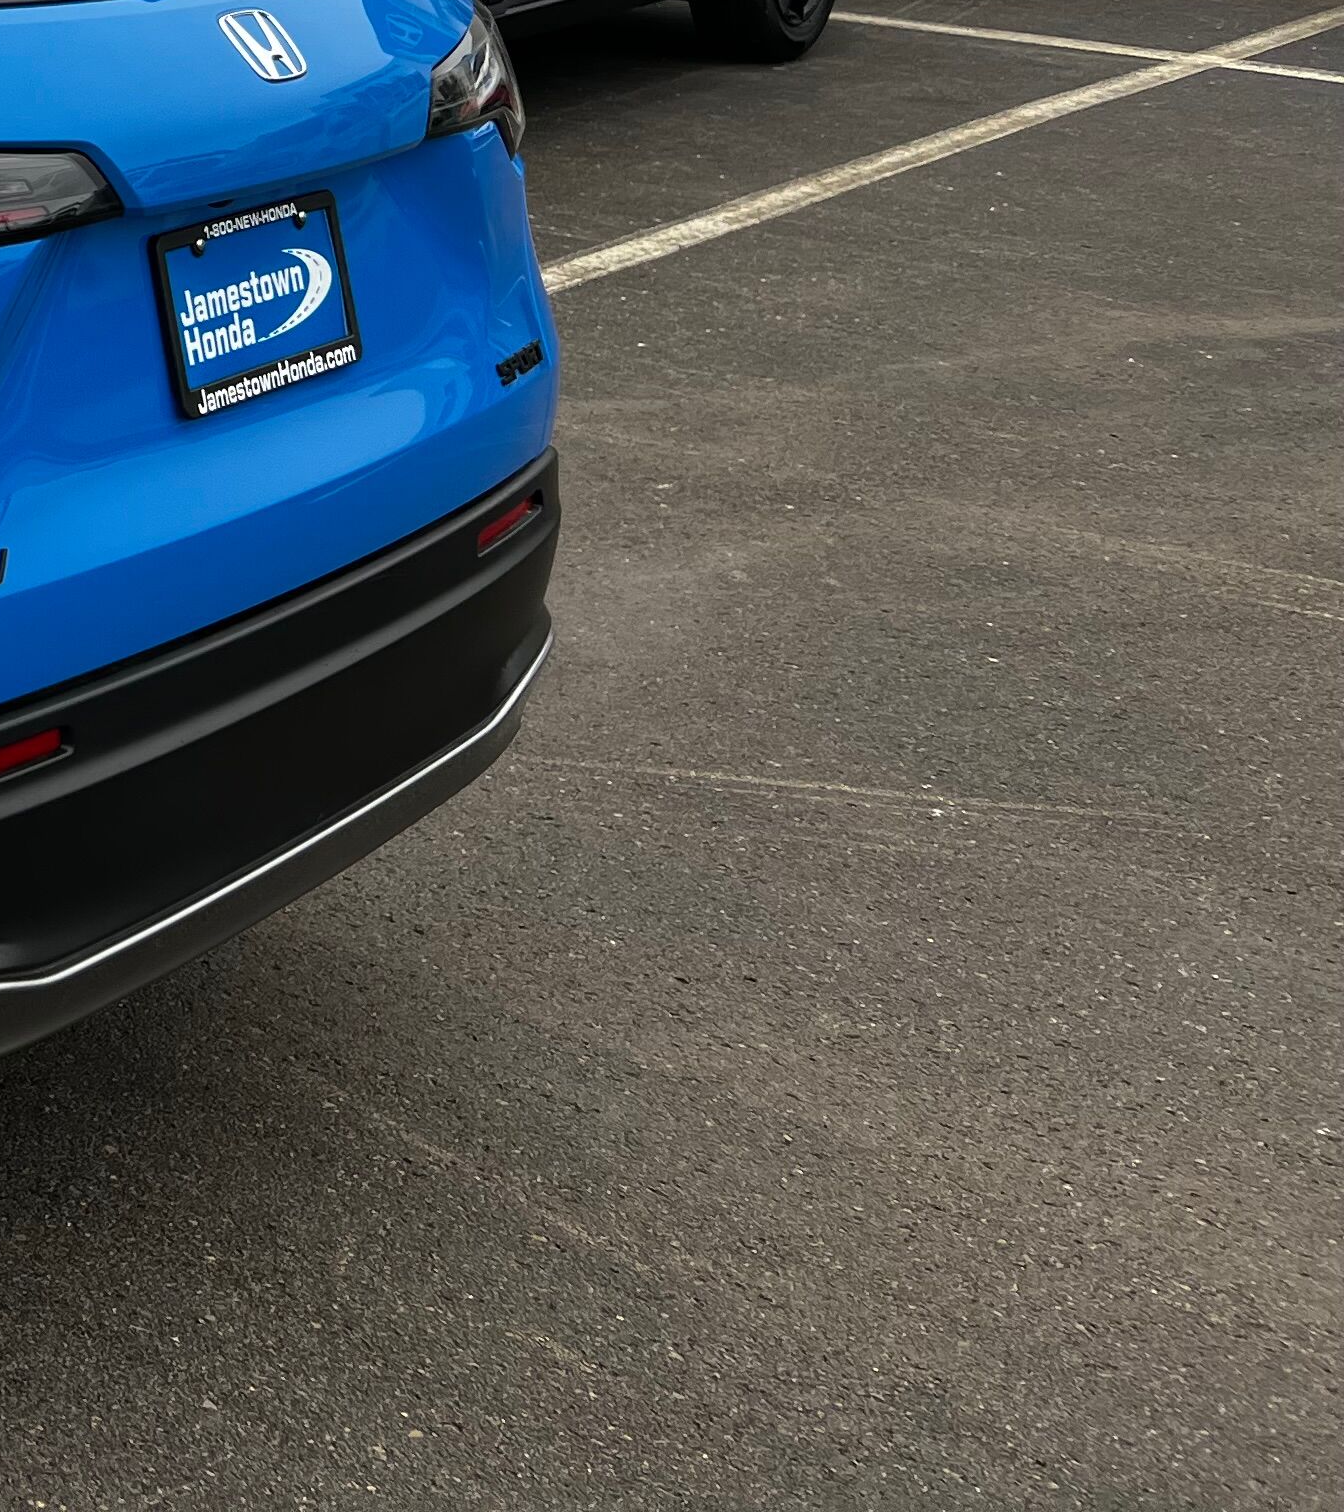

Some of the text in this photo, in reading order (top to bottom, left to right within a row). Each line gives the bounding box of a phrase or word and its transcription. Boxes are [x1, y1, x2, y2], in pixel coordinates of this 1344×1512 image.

[203, 202, 298, 239] 1-800-NEW-HONDA
[180, 265, 305, 327] Jamestown
[184, 313, 256, 366] Honda
[495, 338, 543, 387] SPORT
[198, 344, 357, 414] JamestownHonda.com
